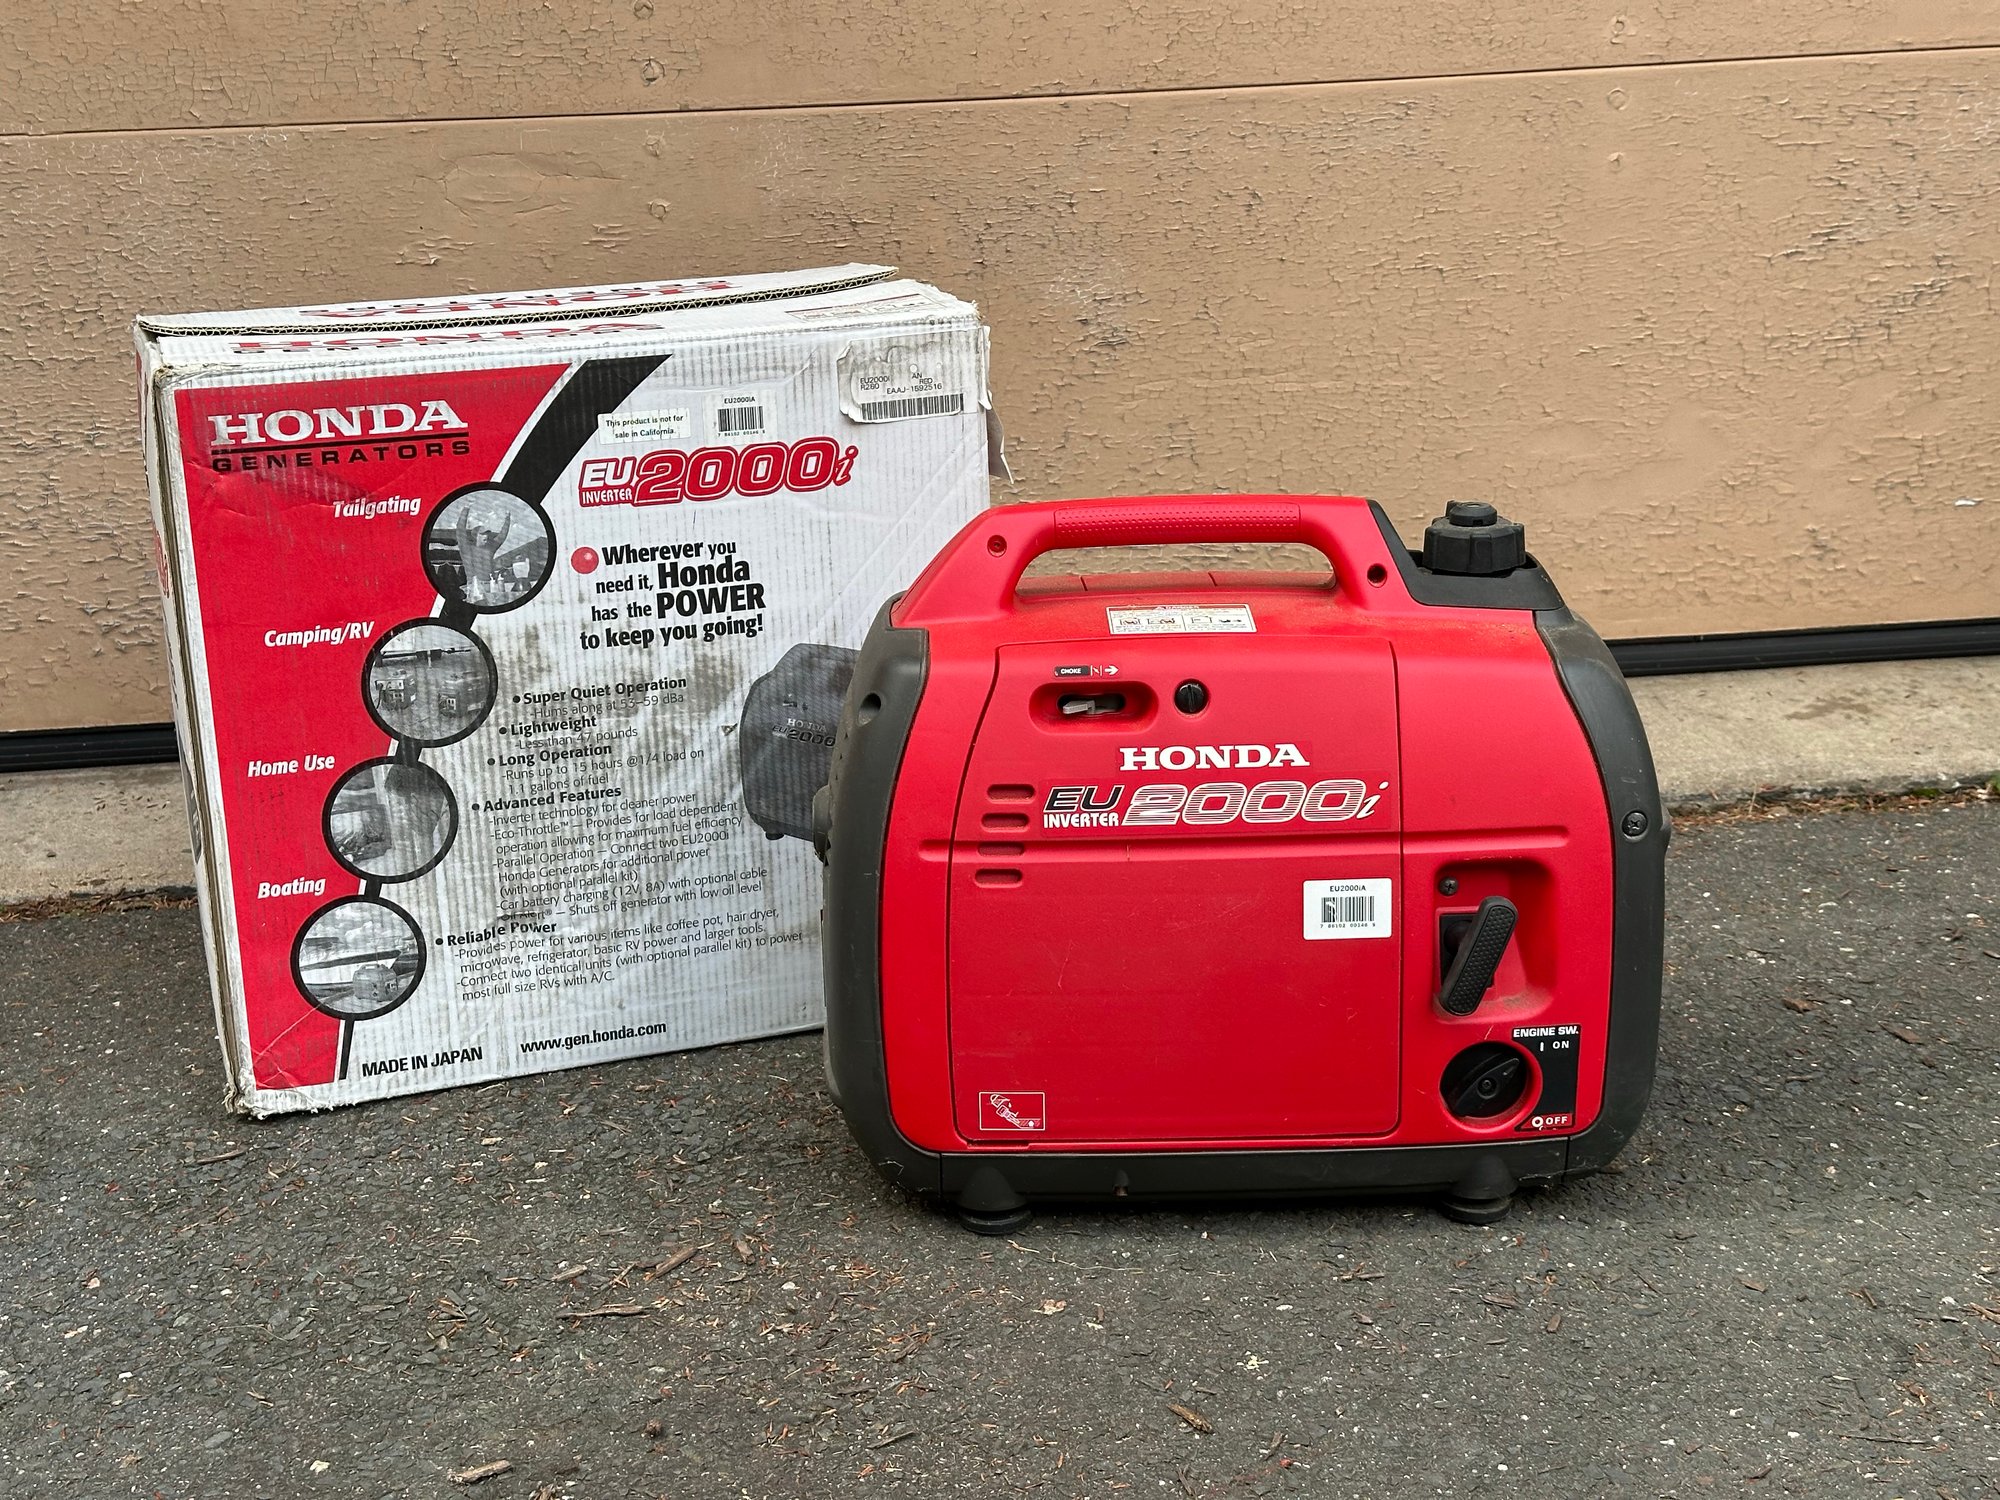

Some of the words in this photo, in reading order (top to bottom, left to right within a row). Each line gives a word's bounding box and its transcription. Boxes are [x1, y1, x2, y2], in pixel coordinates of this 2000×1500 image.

[207, 400, 468, 446] HONDA
[606, 419, 620, 429] This
[622, 418, 650, 426] product
[652, 416, 658, 424] is
[212, 440, 470, 472] GENERATORS
[635, 438, 859, 504] 2000i
[333, 495, 422, 520] Tailgating
[580, 487, 633, 504] INVERTER
[602, 542, 703, 566] Wherever
[708, 542, 737, 559] you
[596, 574, 633, 594] need
[638, 574, 654, 592] it,
[658, 555, 750, 590] Honda
[592, 606, 618, 622] has
[627, 602, 652, 618] the
[656, 583, 766, 619] POWER
[265, 621, 374, 648] Camping/RV
[580, 631, 600, 650] to
[606, 628, 654, 649] keep
[660, 624, 698, 646] you
[702, 614, 764, 642] going!
[523, 690, 566, 706] Super
[571, 684, 611, 701] Quiet
[615, 677, 687, 696] Operation
[572, 702, 602, 714] along
[606, 700, 616, 710] at
[662, 692, 684, 704] dBa
[511, 714, 597, 738] Lightweight
[545, 734, 572, 746] than
[577, 732, 590, 742] 47
[596, 726, 638, 743] pounds
[248, 758, 299, 778] Home
[304, 755, 335, 772] Use
[500, 752, 535, 767] Long
[540, 744, 612, 764] Operation
[538, 768, 552, 779] up
[556, 764, 568, 775] to
[574, 762, 586, 772] 15
[591, 758, 623, 770] hours
[626, 752, 658, 768] @1/4
[663, 749, 686, 762] load
[690, 750, 704, 760] on
[1120, 743, 1310, 772] HONDA
[509, 784, 524, 794] 1.1
[530, 780, 569, 795] gallons
[574, 774, 586, 786] of
[588, 772, 609, 784] fuel
[484, 794, 555, 812] Advanced
[560, 787, 622, 803] Features
[538, 805, 598, 820] technology
[601, 802, 616, 812] for
[620, 798, 658, 810] cleaner
[662, 793, 696, 807] power
[1044, 785, 1125, 812] EU
[1121, 779, 1390, 826] 2000i
[586, 814, 632, 829] Provides
[635, 812, 650, 824] for
[653, 808, 676, 820] load
[680, 802, 738, 818] dependent
[1044, 812, 1119, 828] INVERTER
[496, 839, 548, 856] operation
[551, 834, 595, 848] allowing
[598, 830, 611, 842] for
[616, 825, 669, 840] maximum
[672, 820, 691, 832] fuel
[694, 815, 743, 830] efficiency
[540, 848, 594, 865] Operation
[611, 842, 656, 855] Connect
[660, 838, 678, 848] two
[682, 830, 730, 846] EU2000i
[498, 868, 536, 883] Honda
[540, 862, 600, 877] Generators
[603, 859, 617, 870] for
[621, 852, 673, 868] additional
[676, 847, 710, 863] power
[258, 877, 326, 899] Boating
[500, 884, 528, 898] (with
[532, 877, 576, 894] optional
[580, 872, 618, 888] parallel
[621, 870, 638, 882] kit)
[522, 894, 560, 908] battery
[563, 888, 609, 903] charging
[646, 880, 666, 894] 8A)
[669, 878, 691, 890] with
[694, 870, 737, 886] optional
[740, 867, 768, 880] cable
[570, 902, 599, 916] Shuts
[603, 901, 617, 912] off
[621, 894, 672, 912] generator
[674, 890, 697, 903] with
[700, 887, 720, 898] low
[722, 884, 734, 896] oil
[737, 880, 762, 894] level
[447, 924, 506, 946] Reliable
[510, 922, 557, 934] Power
[510, 937, 545, 952] power
[550, 935, 564, 946] for
[567, 931, 608, 944] various
[610, 926, 640, 939] items
[644, 922, 662, 934] like
[666, 918, 700, 932] coffee
[703, 916, 724, 928] pot,
[726, 911, 746, 924] hair
[750, 908, 780, 922] dryer,
[461, 954, 524, 973] microwave,
[528, 946, 590, 964] refrigerator,
[594, 944, 624, 956] basic
[626, 940, 640, 950] RV
[644, 936, 678, 952] power
[681, 930, 701, 942] and
[704, 928, 734, 942] larger
[512, 968, 532, 978] two
[535, 960, 582, 976] identical
[585, 958, 612, 970] units
[616, 954, 644, 969] (with
[647, 946, 690, 962] optional
[694, 939, 732, 957] parallel
[736, 936, 752, 950] kit)
[756, 936, 766, 946] to
[770, 932, 803, 947] power
[462, 988, 490, 1001] most
[494, 982, 511, 994] full
[514, 980, 536, 993] size
[540, 978, 561, 990] RVs
[564, 974, 587, 987] with
[590, 970, 615, 984] A/C.
[520, 1022, 668, 1054] www.gen.honda.com
[1513, 1027, 1556, 1038] ENGINE
[1558, 1026, 1579, 1035] SW.
[1552, 1040, 1570, 1050] ON
[362, 1057, 408, 1077] MADE
[412, 1054, 428, 1070] IN
[431, 1046, 483, 1068] JAPAN
[1546, 1116, 1568, 1125] OFF
